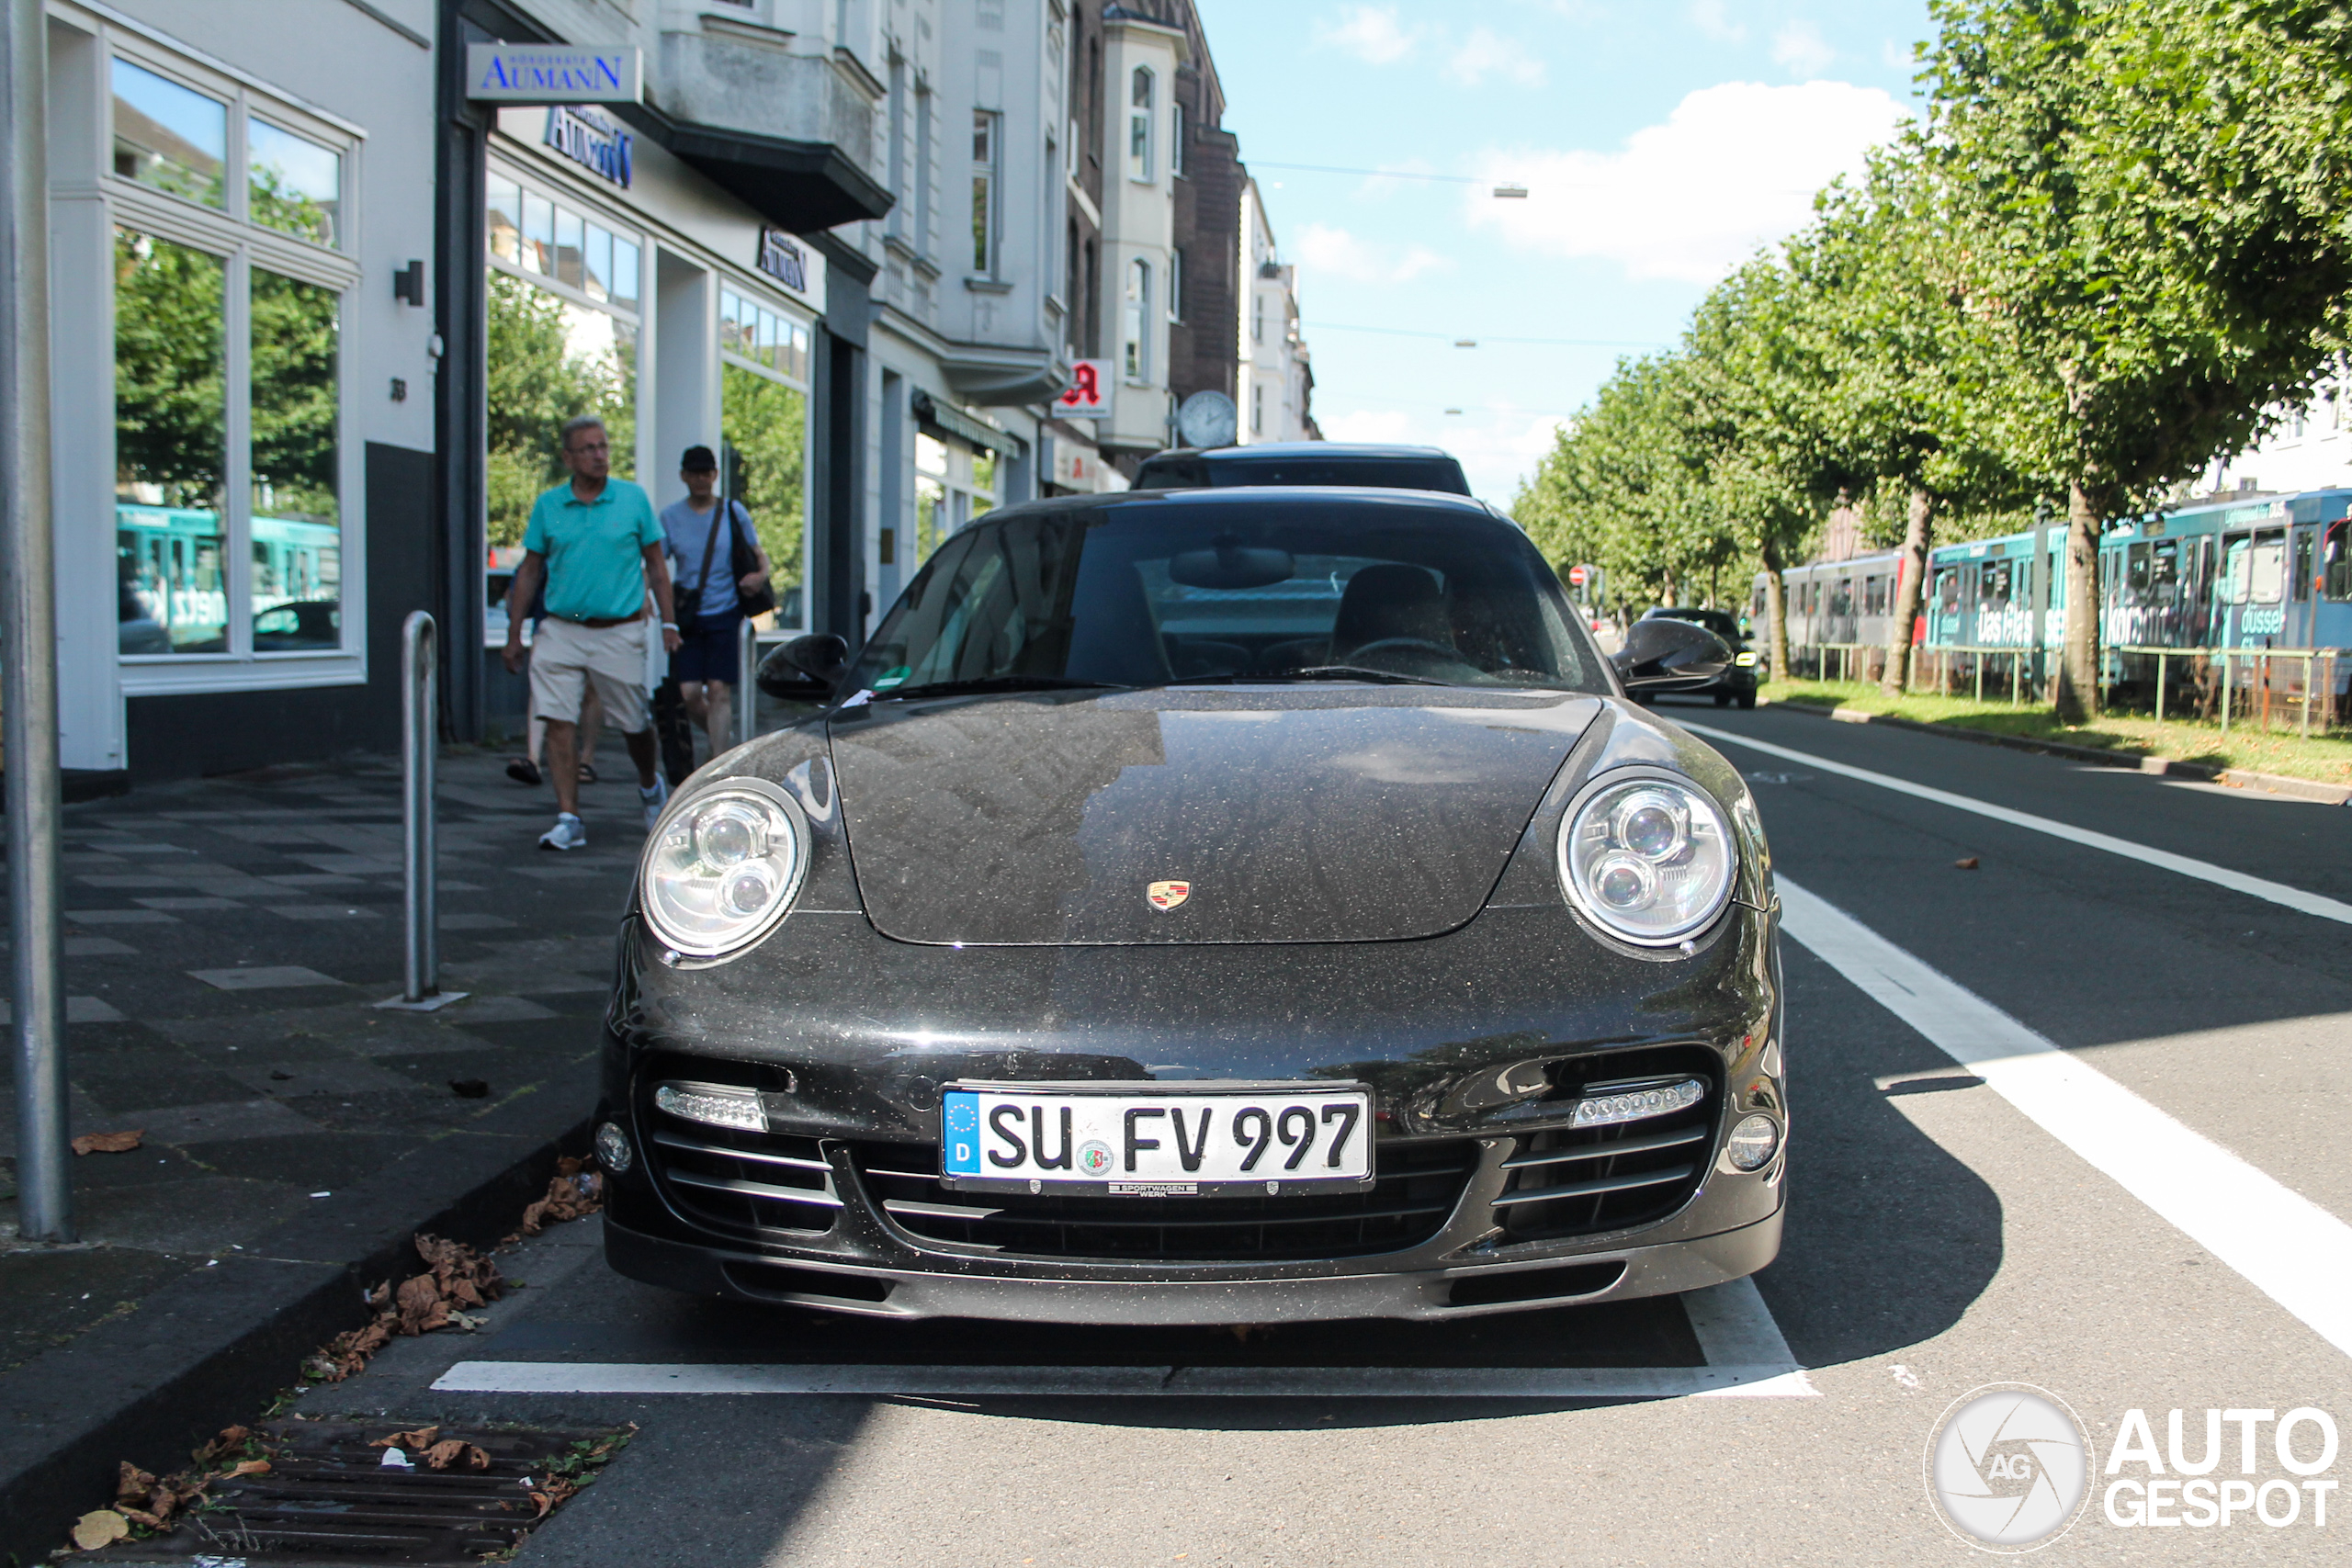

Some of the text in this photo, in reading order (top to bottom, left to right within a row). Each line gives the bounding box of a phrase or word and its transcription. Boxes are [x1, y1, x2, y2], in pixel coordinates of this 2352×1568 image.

[989, 1104, 1072, 1170] SU
[1125, 1108, 1212, 1172] FV
[1232, 1104, 1360, 1171] 997
[956, 1143, 969, 1161] D
[1120, 1184, 1186, 1192] SPORTWAGEN
[1139, 1190, 1168, 1198] WERK
